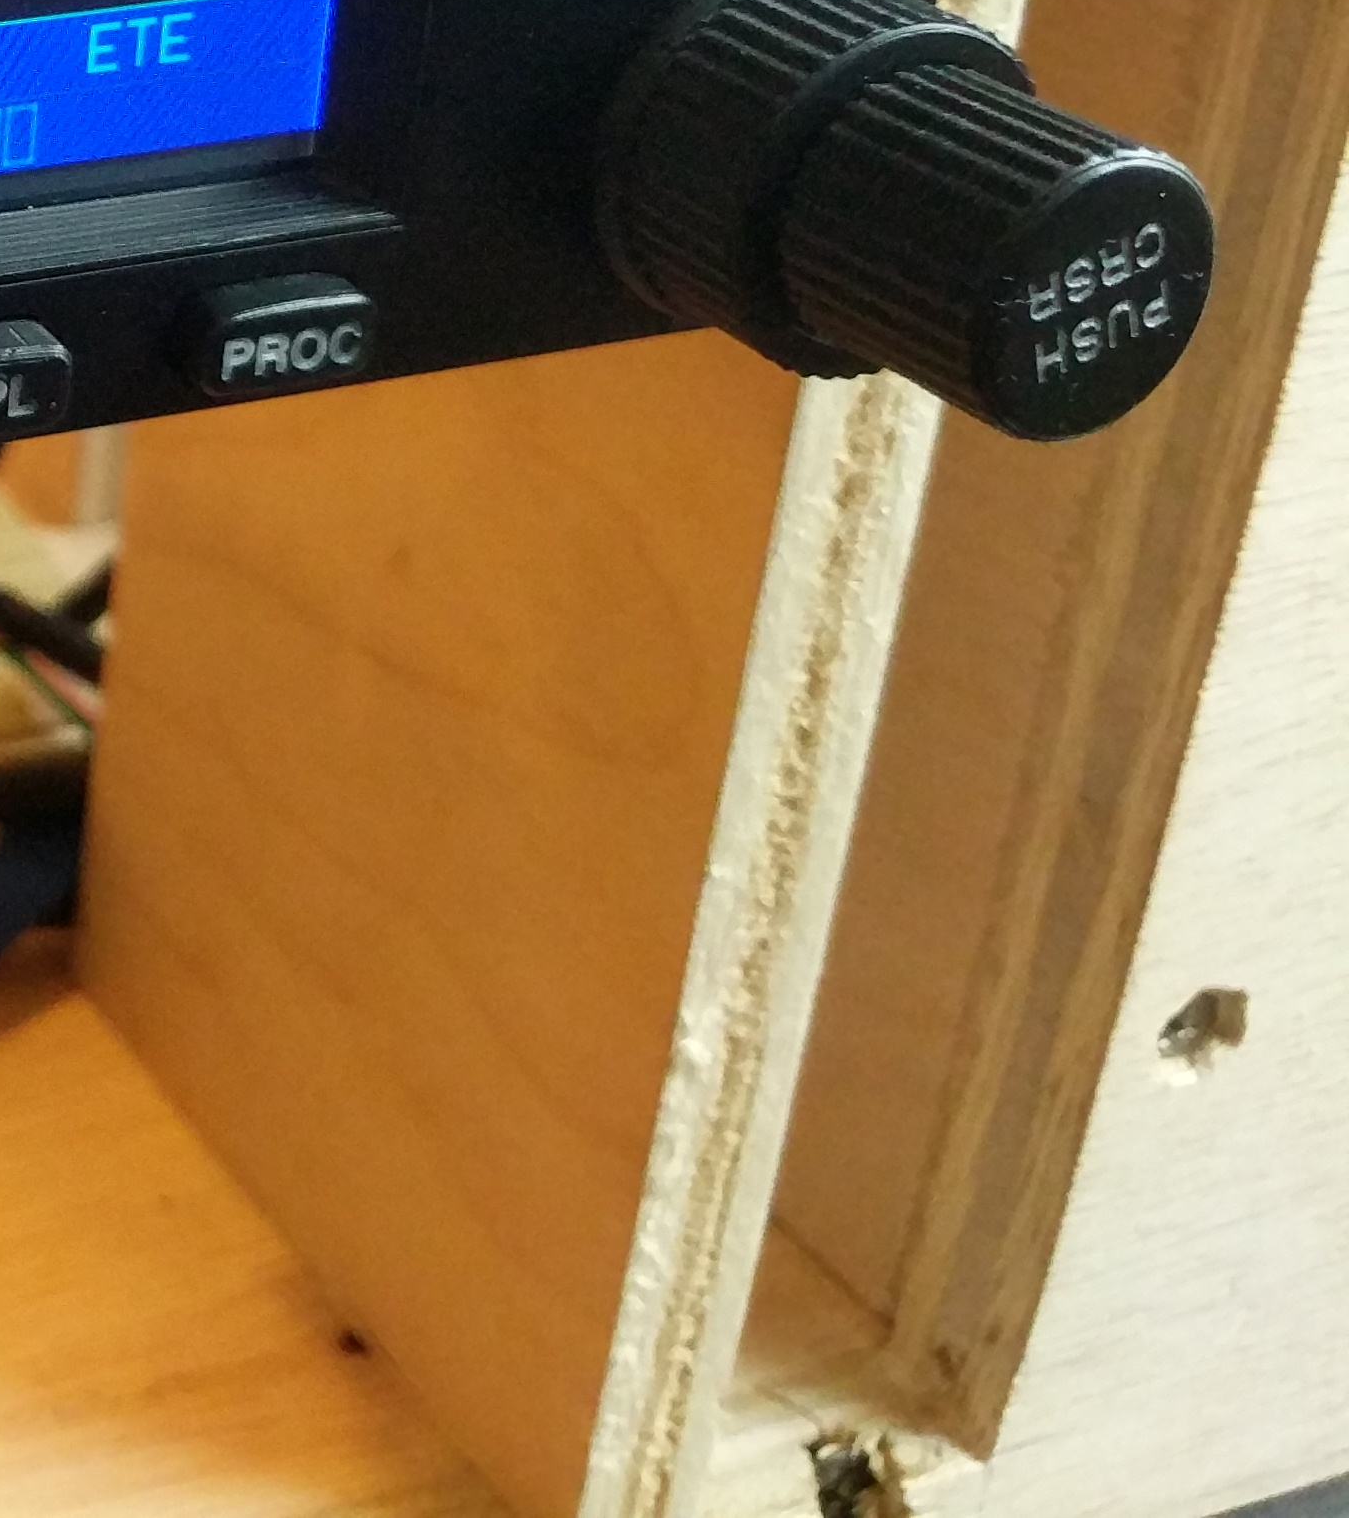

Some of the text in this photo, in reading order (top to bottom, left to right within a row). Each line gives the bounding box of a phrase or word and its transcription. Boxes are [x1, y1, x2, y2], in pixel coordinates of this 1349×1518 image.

[85, 12, 195, 74] ETE
[1026, 222, 1167, 323] CRSR
[218, 318, 367, 382] PROC
[1033, 278, 1174, 385] PUSH
